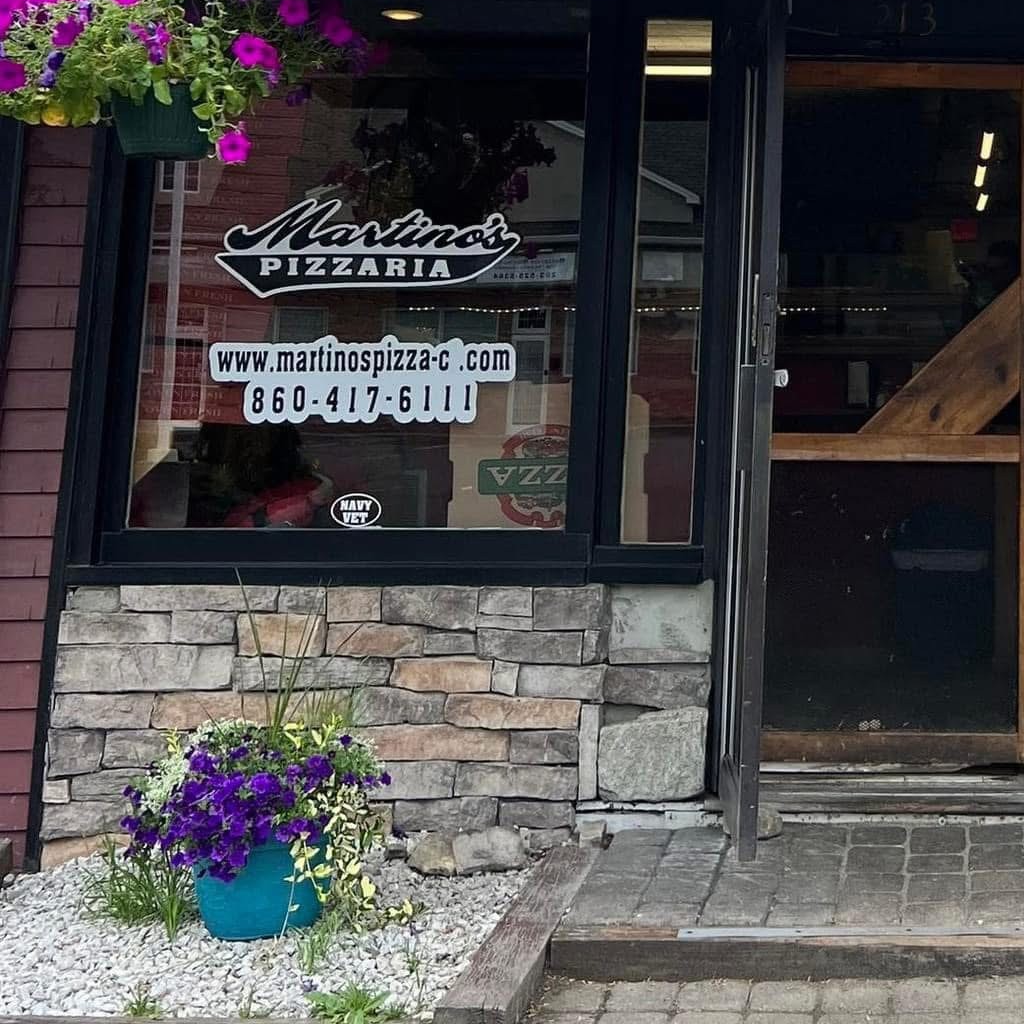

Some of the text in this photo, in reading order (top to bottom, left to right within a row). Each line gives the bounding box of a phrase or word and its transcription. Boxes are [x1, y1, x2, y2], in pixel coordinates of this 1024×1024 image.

[226, 199, 520, 254] Martino's
[258, 256, 451, 278] PIZZARIA
[251, 384, 471, 414] 860-417-6111
[339, 499, 373, 511] NAVY
[342, 511, 369, 524] VET
